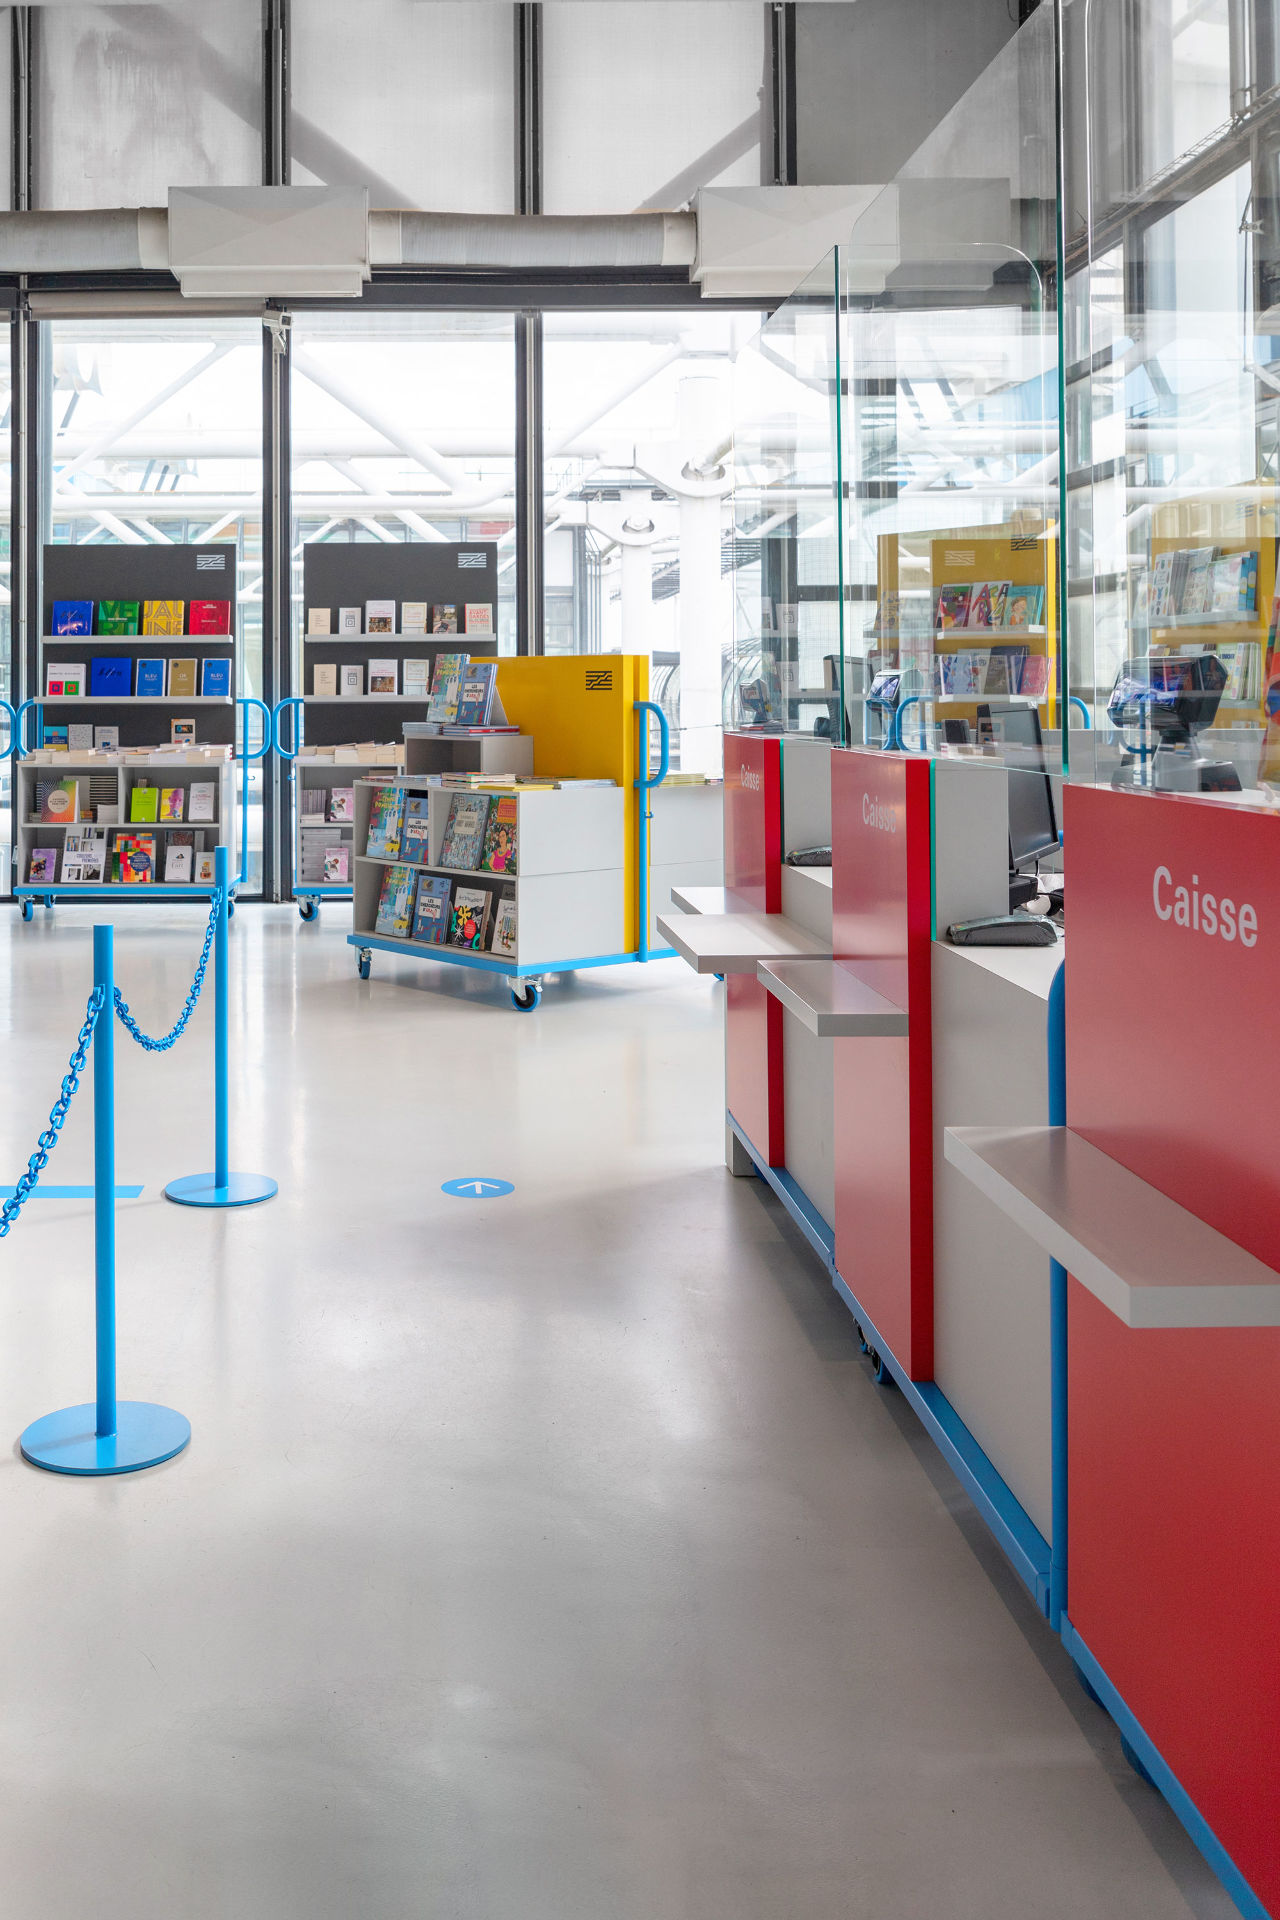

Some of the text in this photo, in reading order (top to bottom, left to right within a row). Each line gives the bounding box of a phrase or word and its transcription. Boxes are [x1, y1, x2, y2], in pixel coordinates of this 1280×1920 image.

[741, 764, 760, 791] Caisse
[863, 793, 896, 832] Caisse
[1153, 865, 1258, 947] Caisse
